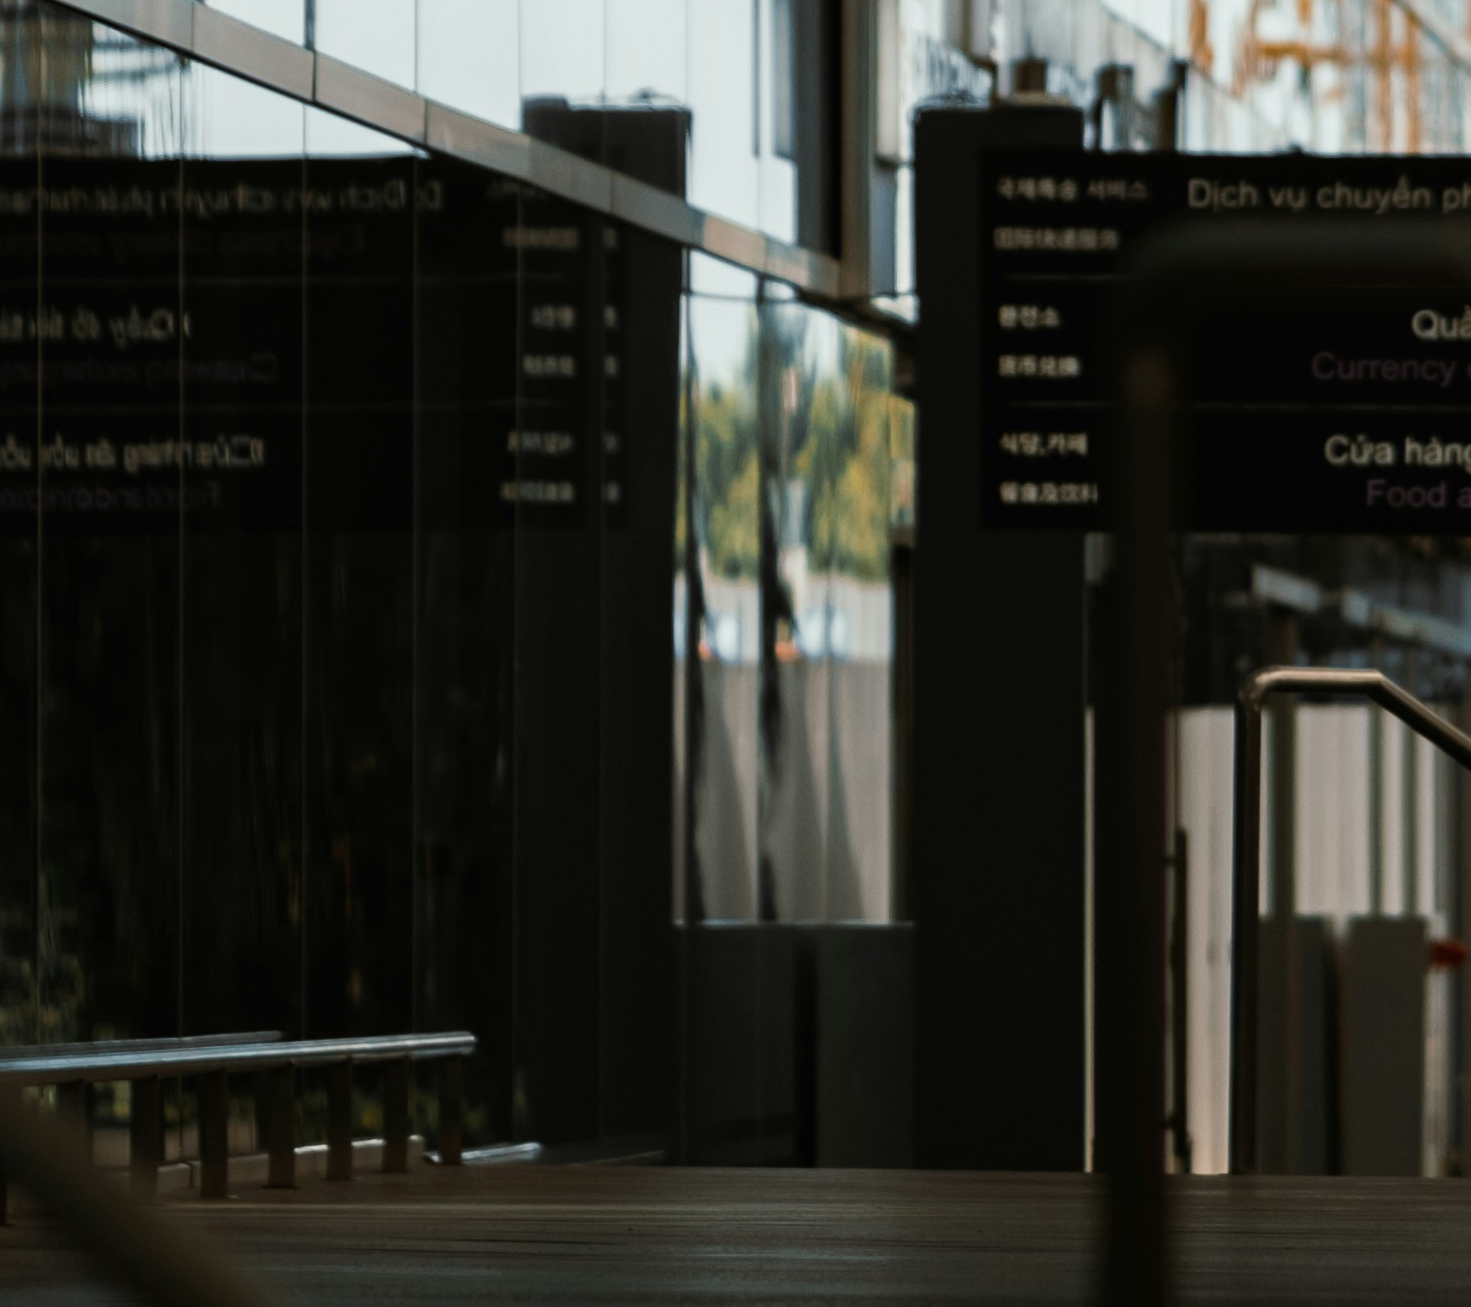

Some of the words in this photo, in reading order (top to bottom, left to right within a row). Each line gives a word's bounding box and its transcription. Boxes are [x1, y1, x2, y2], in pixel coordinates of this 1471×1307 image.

[1187, 177, 1259, 213] Dịch
[1268, 183, 1308, 213] vụ
[1311, 351, 1458, 388] Currency
[1366, 478, 1447, 509] Food
